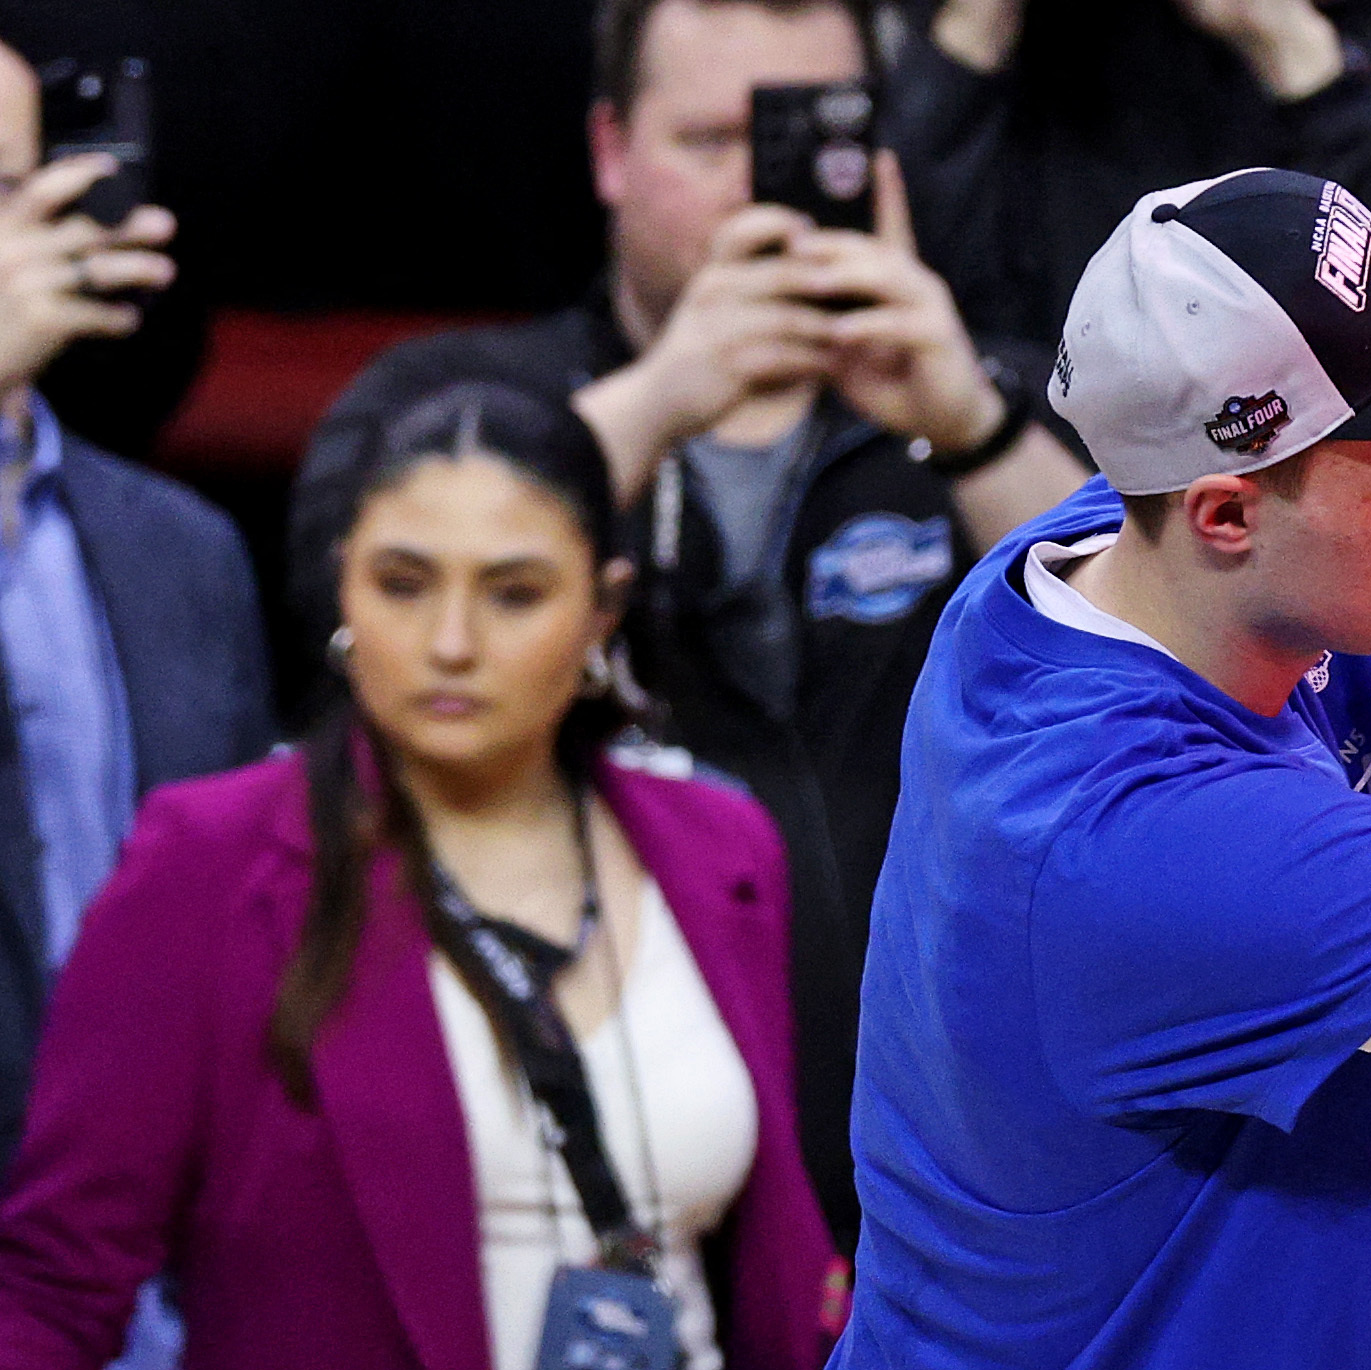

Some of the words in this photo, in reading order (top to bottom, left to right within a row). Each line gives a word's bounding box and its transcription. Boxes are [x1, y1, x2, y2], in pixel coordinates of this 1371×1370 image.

[1310, 218, 1327, 252] NCAA
[1210, 420, 1248, 442] FINAL
[1246, 398, 1284, 430] FOUR
